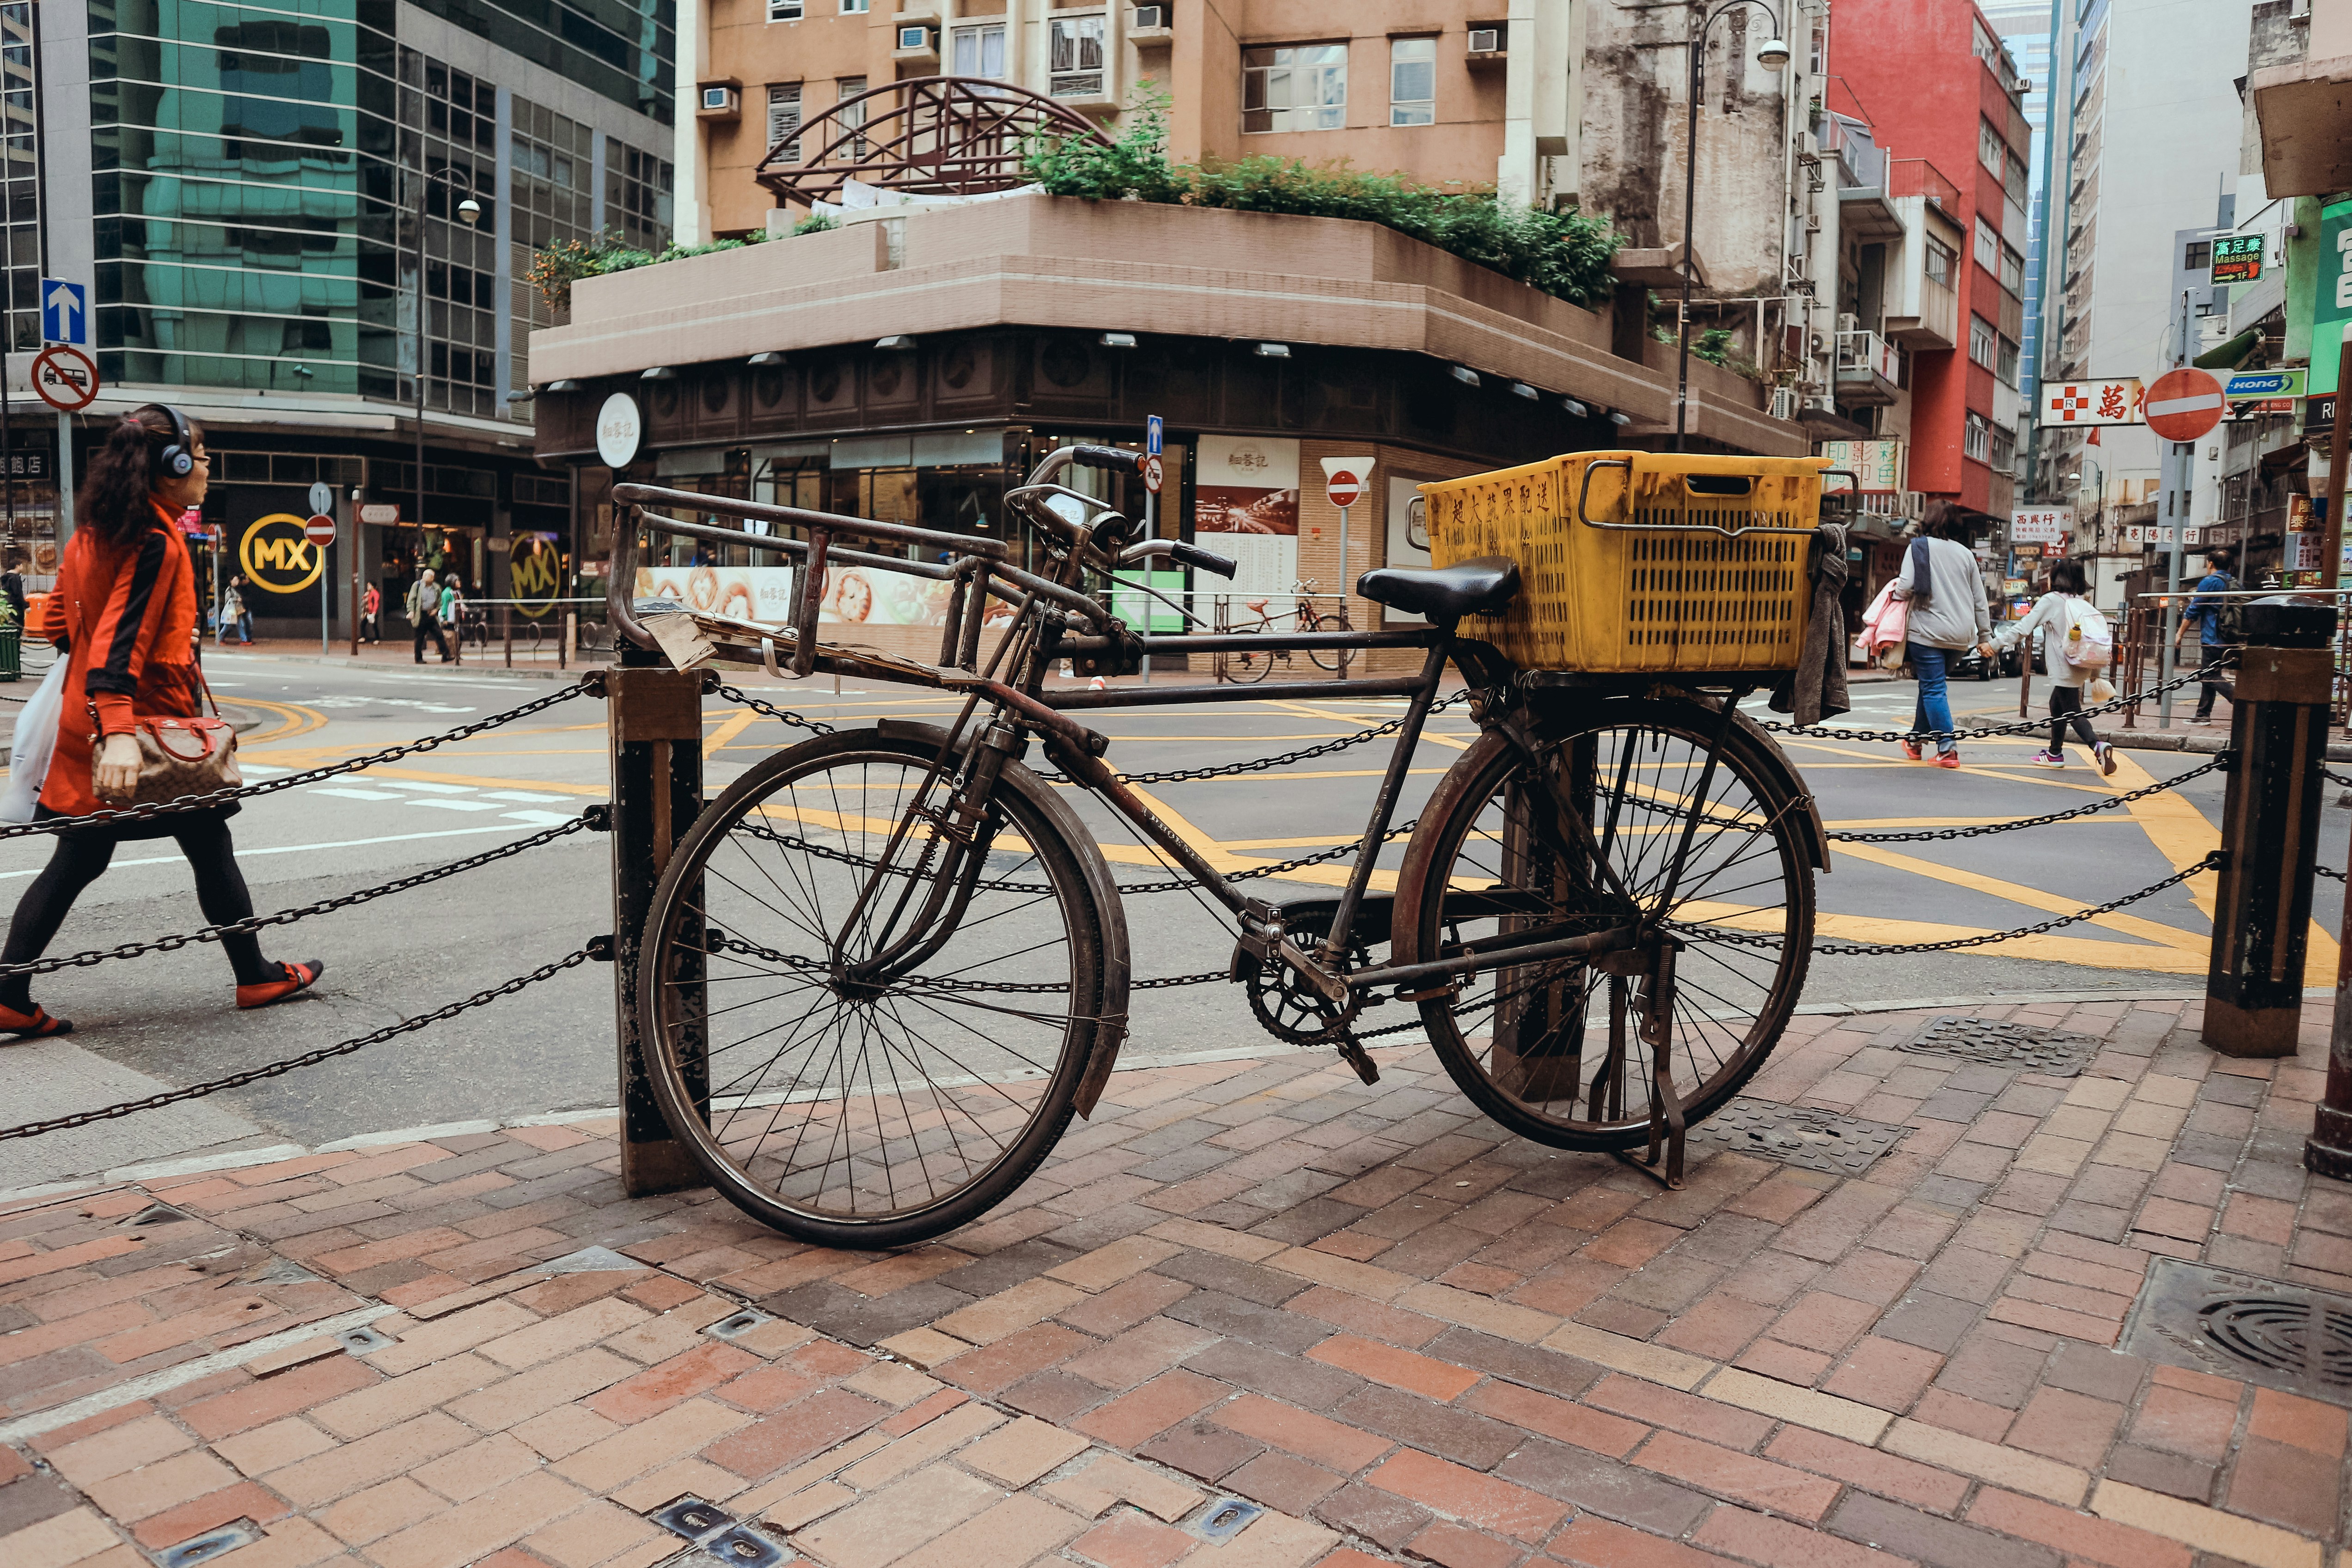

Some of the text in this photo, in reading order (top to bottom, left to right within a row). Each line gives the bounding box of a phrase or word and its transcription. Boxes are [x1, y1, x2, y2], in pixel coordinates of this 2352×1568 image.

[2215, 253, 2259, 264] Massage
[2237, 271, 2248, 280] 1F
[2065, 399, 2074, 408] R
[255, 537, 312, 570] MX
[511, 549, 555, 599] MX
